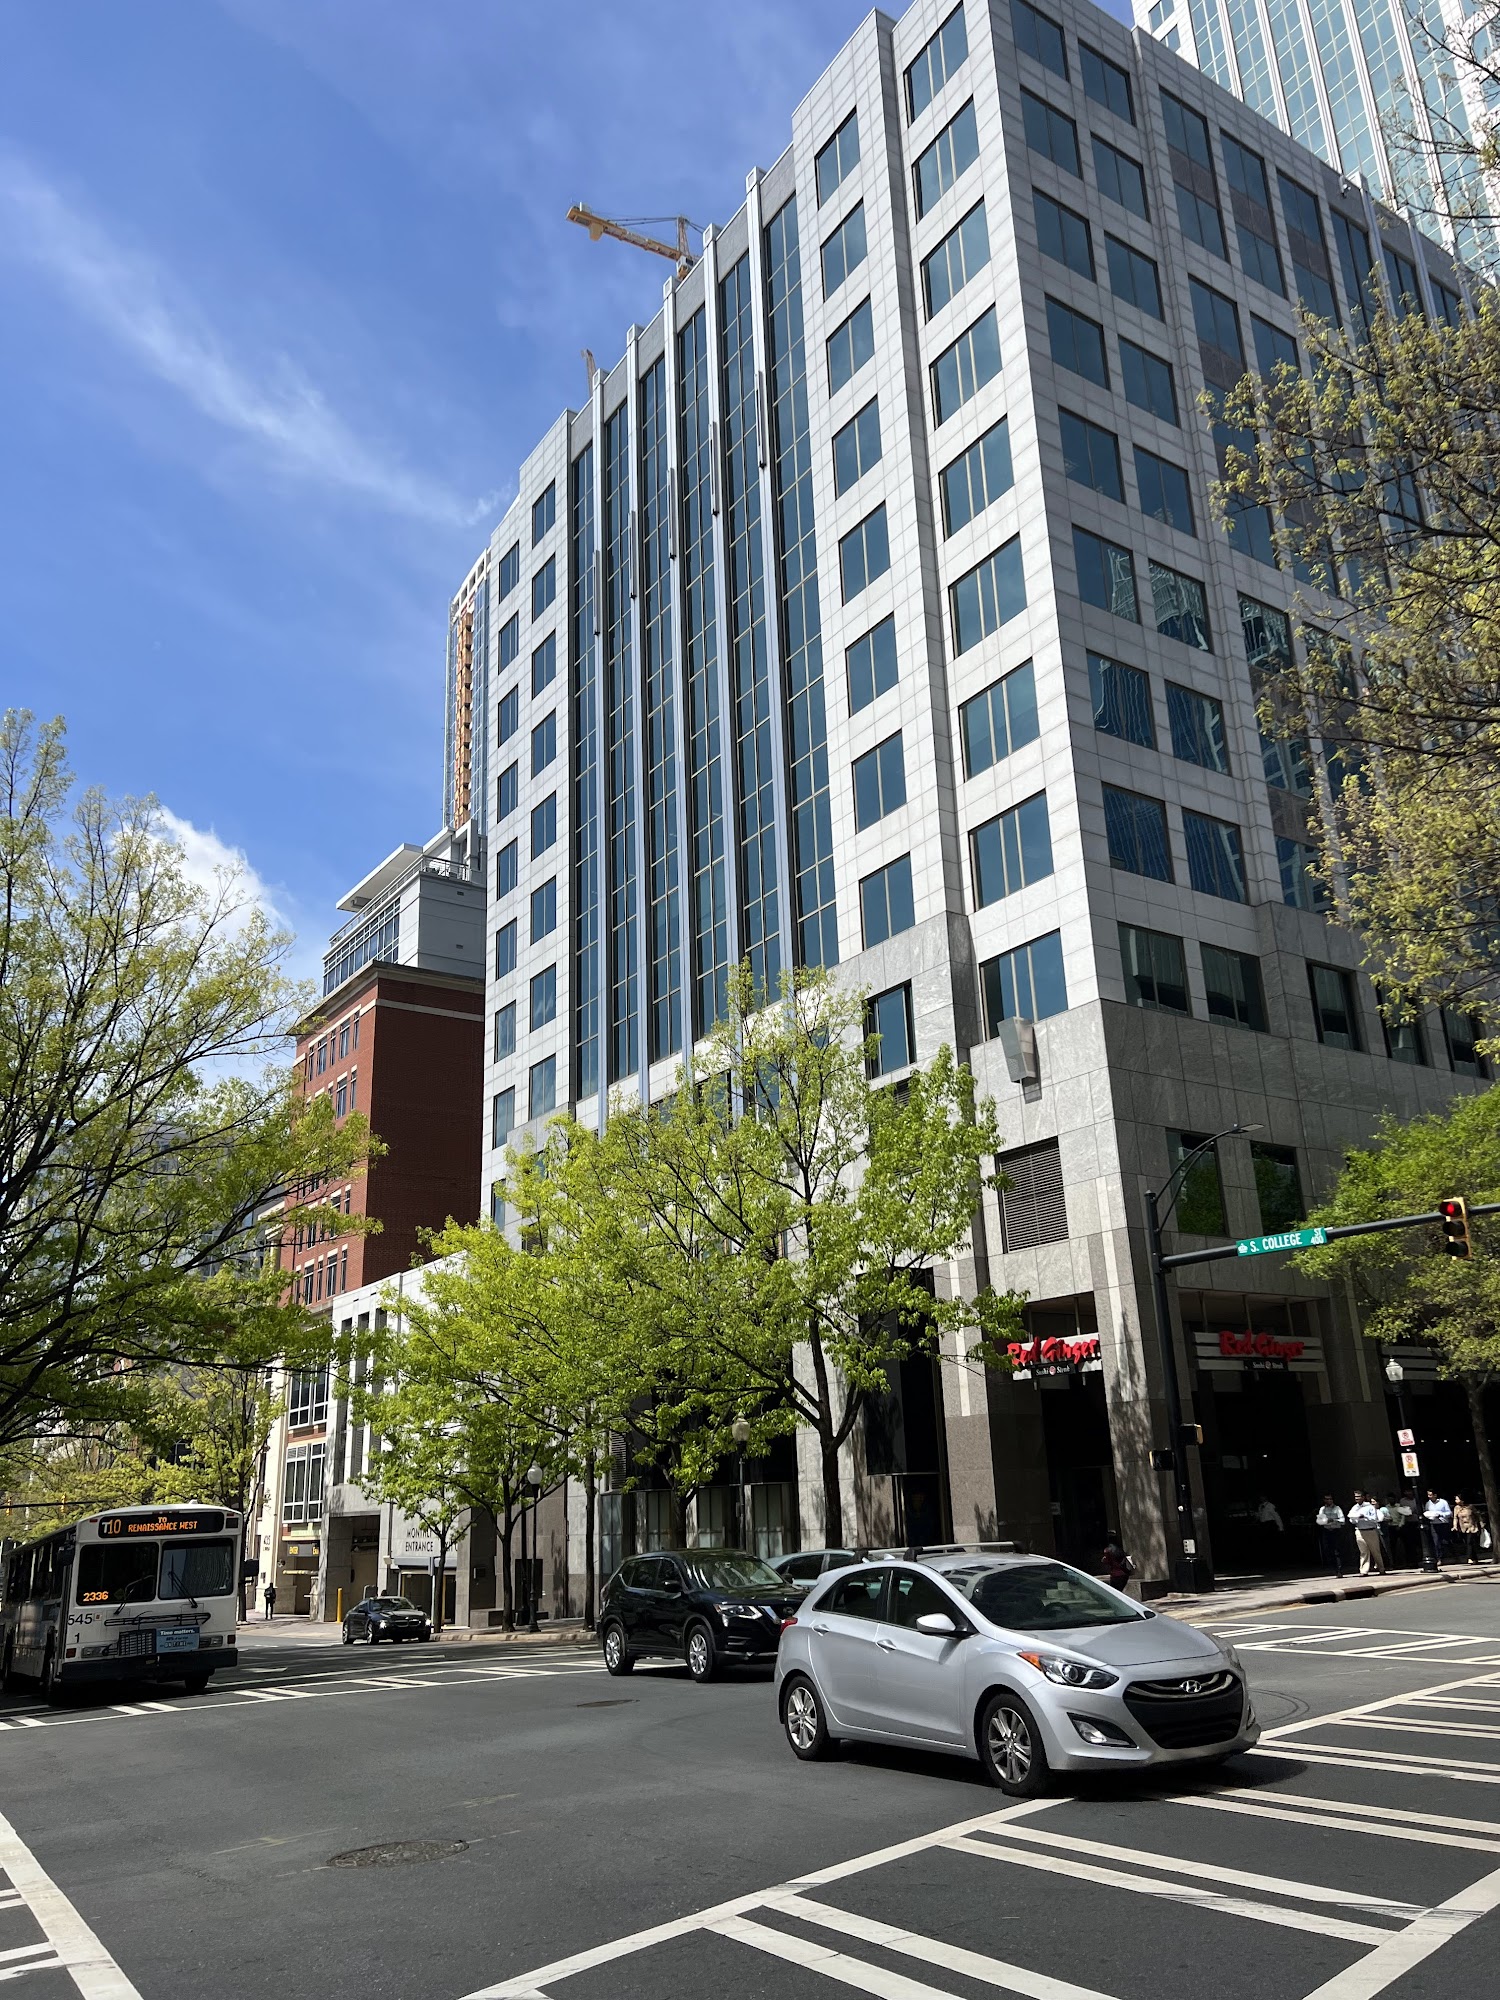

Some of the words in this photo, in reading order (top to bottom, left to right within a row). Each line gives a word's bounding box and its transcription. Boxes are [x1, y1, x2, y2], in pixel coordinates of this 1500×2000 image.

[1250, 1241, 1259, 1252] S.
[1262, 1233, 1302, 1250] COLLEGE
[1311, 1236, 1324, 1244] 400
[1007, 1335, 1039, 1366] Red
[1041, 1336, 1098, 1365] Ginger
[1219, 1328, 1253, 1356] Red
[1256, 1332, 1305, 1362] Ginger
[128, 1523, 177, 1532] RENAISSANCE
[179, 1520, 198, 1530] WEST
[405, 1541, 434, 1552] ENTRANCE
[83, 1590, 109, 1602] 2336
[67, 1613, 93, 1626] 545
[74, 1632, 80, 1644] 1
